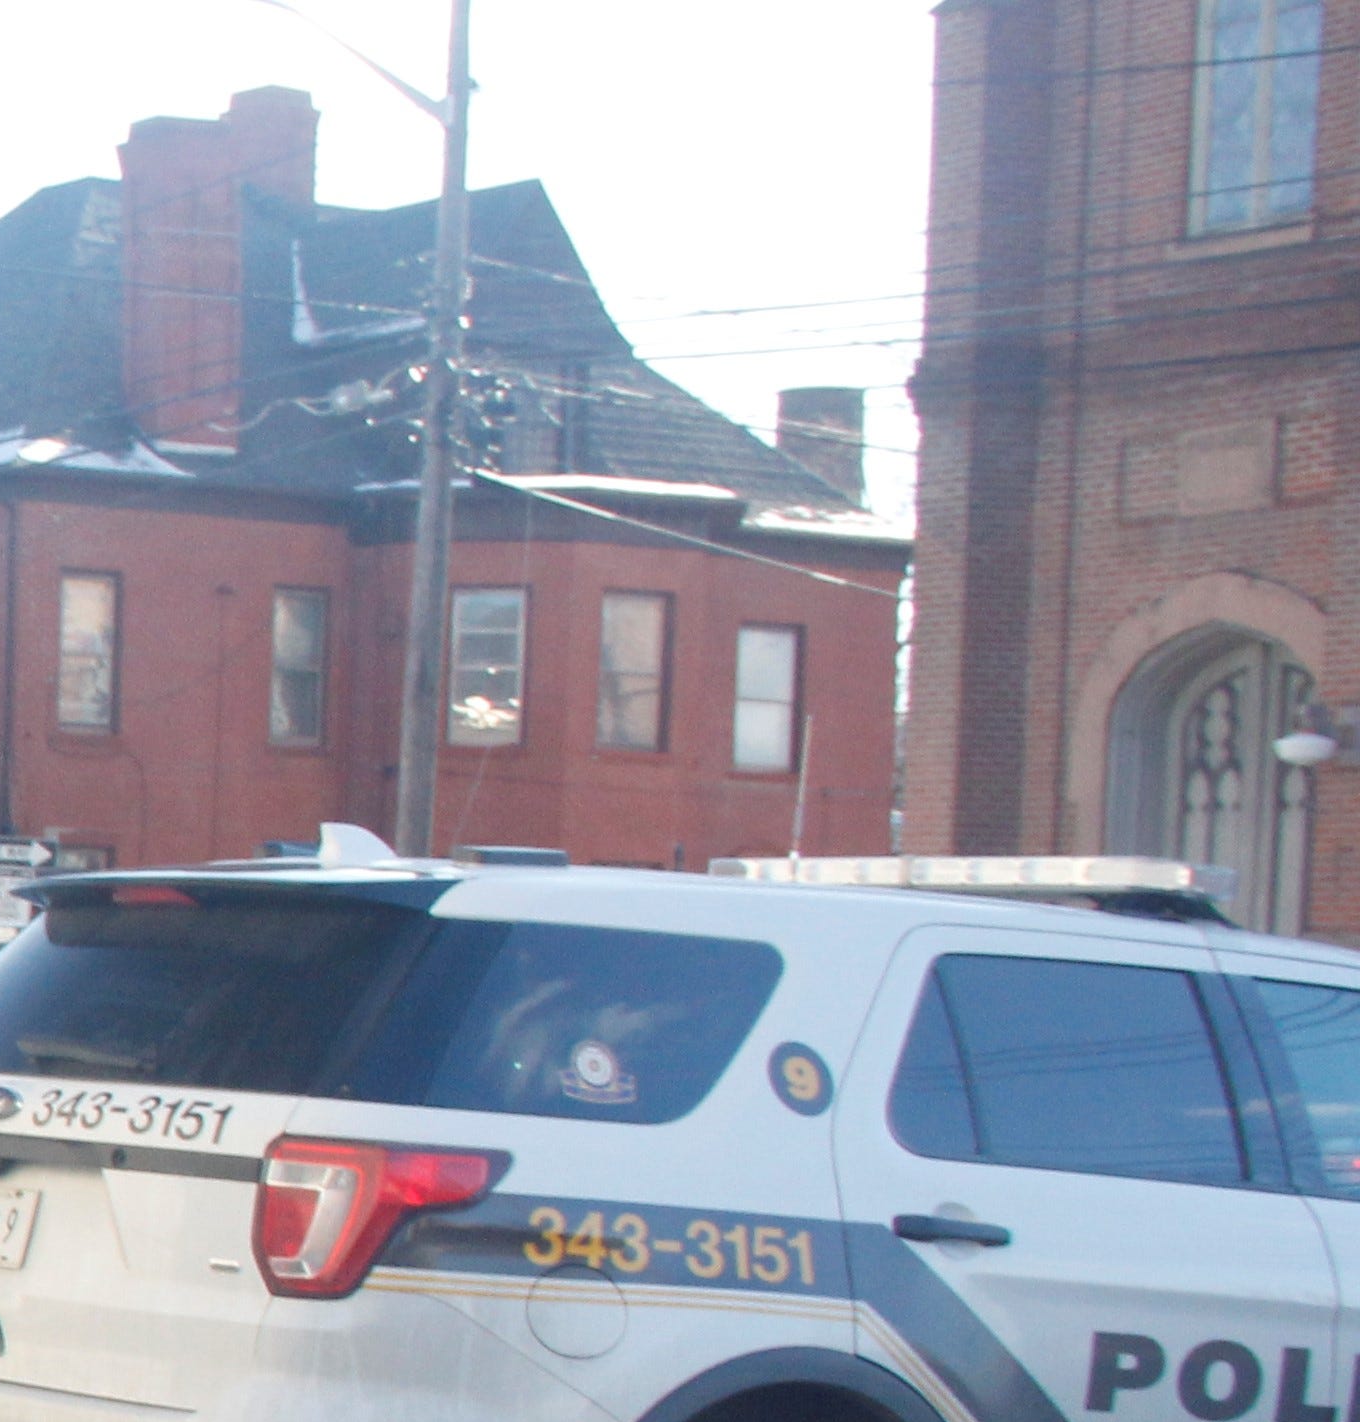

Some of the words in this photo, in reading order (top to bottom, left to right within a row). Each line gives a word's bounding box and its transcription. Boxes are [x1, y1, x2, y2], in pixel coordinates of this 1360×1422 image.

[783, 1056, 820, 1101] 9
[32, 1088, 233, 1144] 343-3151
[523, 1206, 816, 1286] 343-3151
